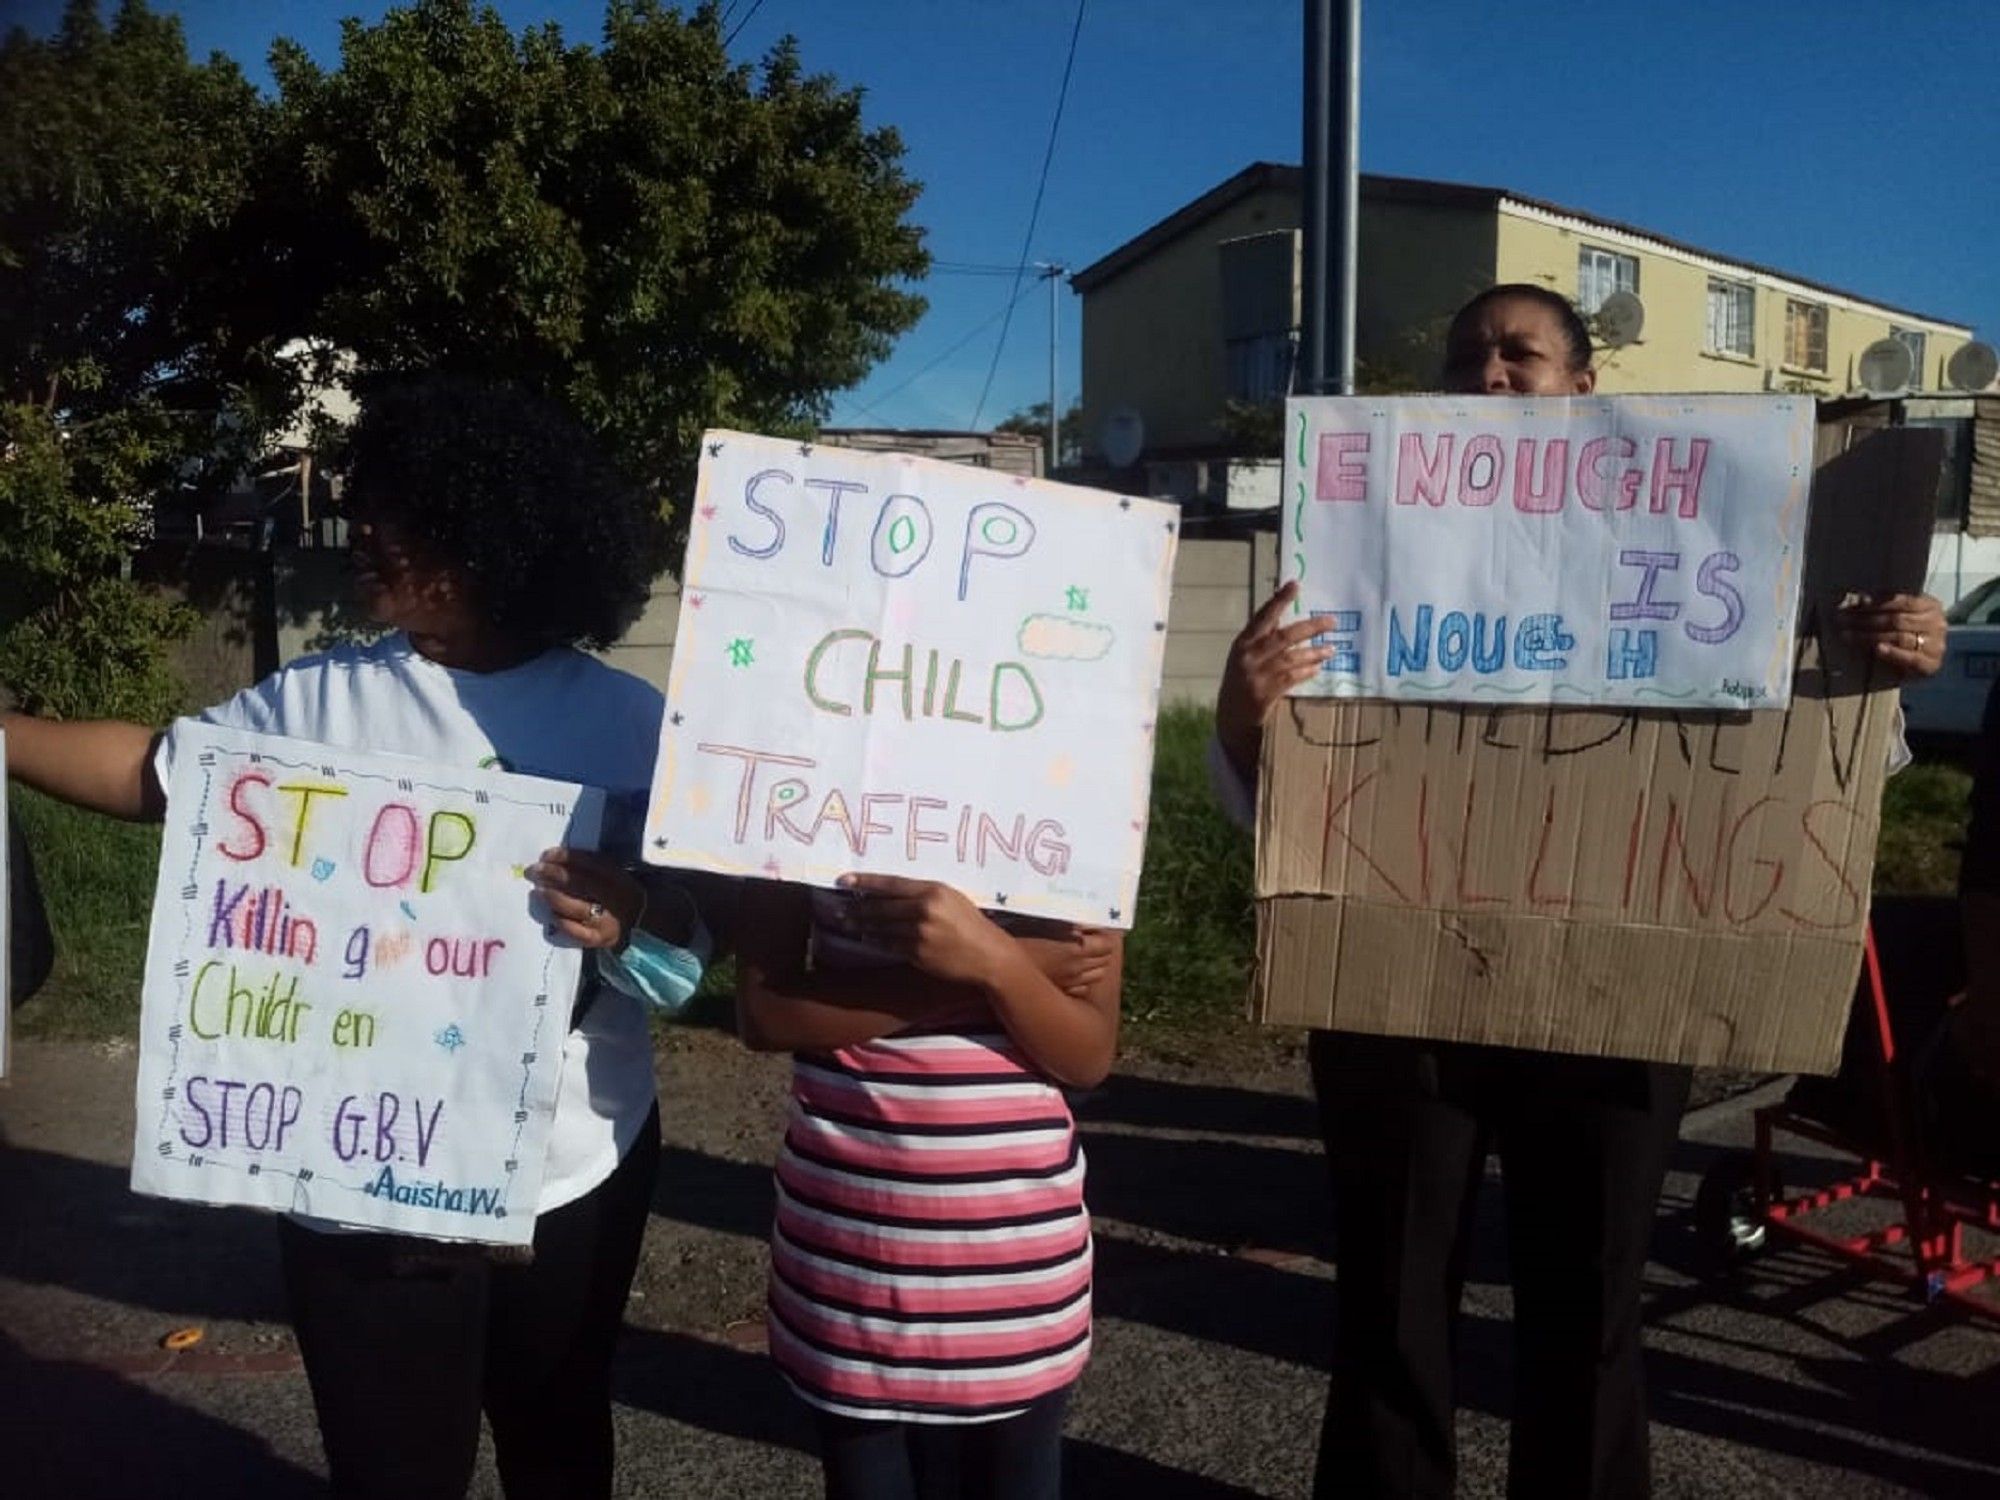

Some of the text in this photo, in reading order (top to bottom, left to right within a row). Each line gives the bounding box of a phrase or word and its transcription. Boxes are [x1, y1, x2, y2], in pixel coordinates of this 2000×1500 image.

[1316, 431, 1710, 518] ENOUGH
[728, 469, 1036, 600] STOP
[1610, 551, 1744, 645] IS
[805, 629, 1044, 731] CHILD
[217, 775, 476, 892] STOP
[698, 743, 1072, 876] TRAFFING
[1321, 773, 1863, 928] KILLINGS
[426, 937, 505, 977] our
[180, 1076, 444, 1167] STOP G.B.V
